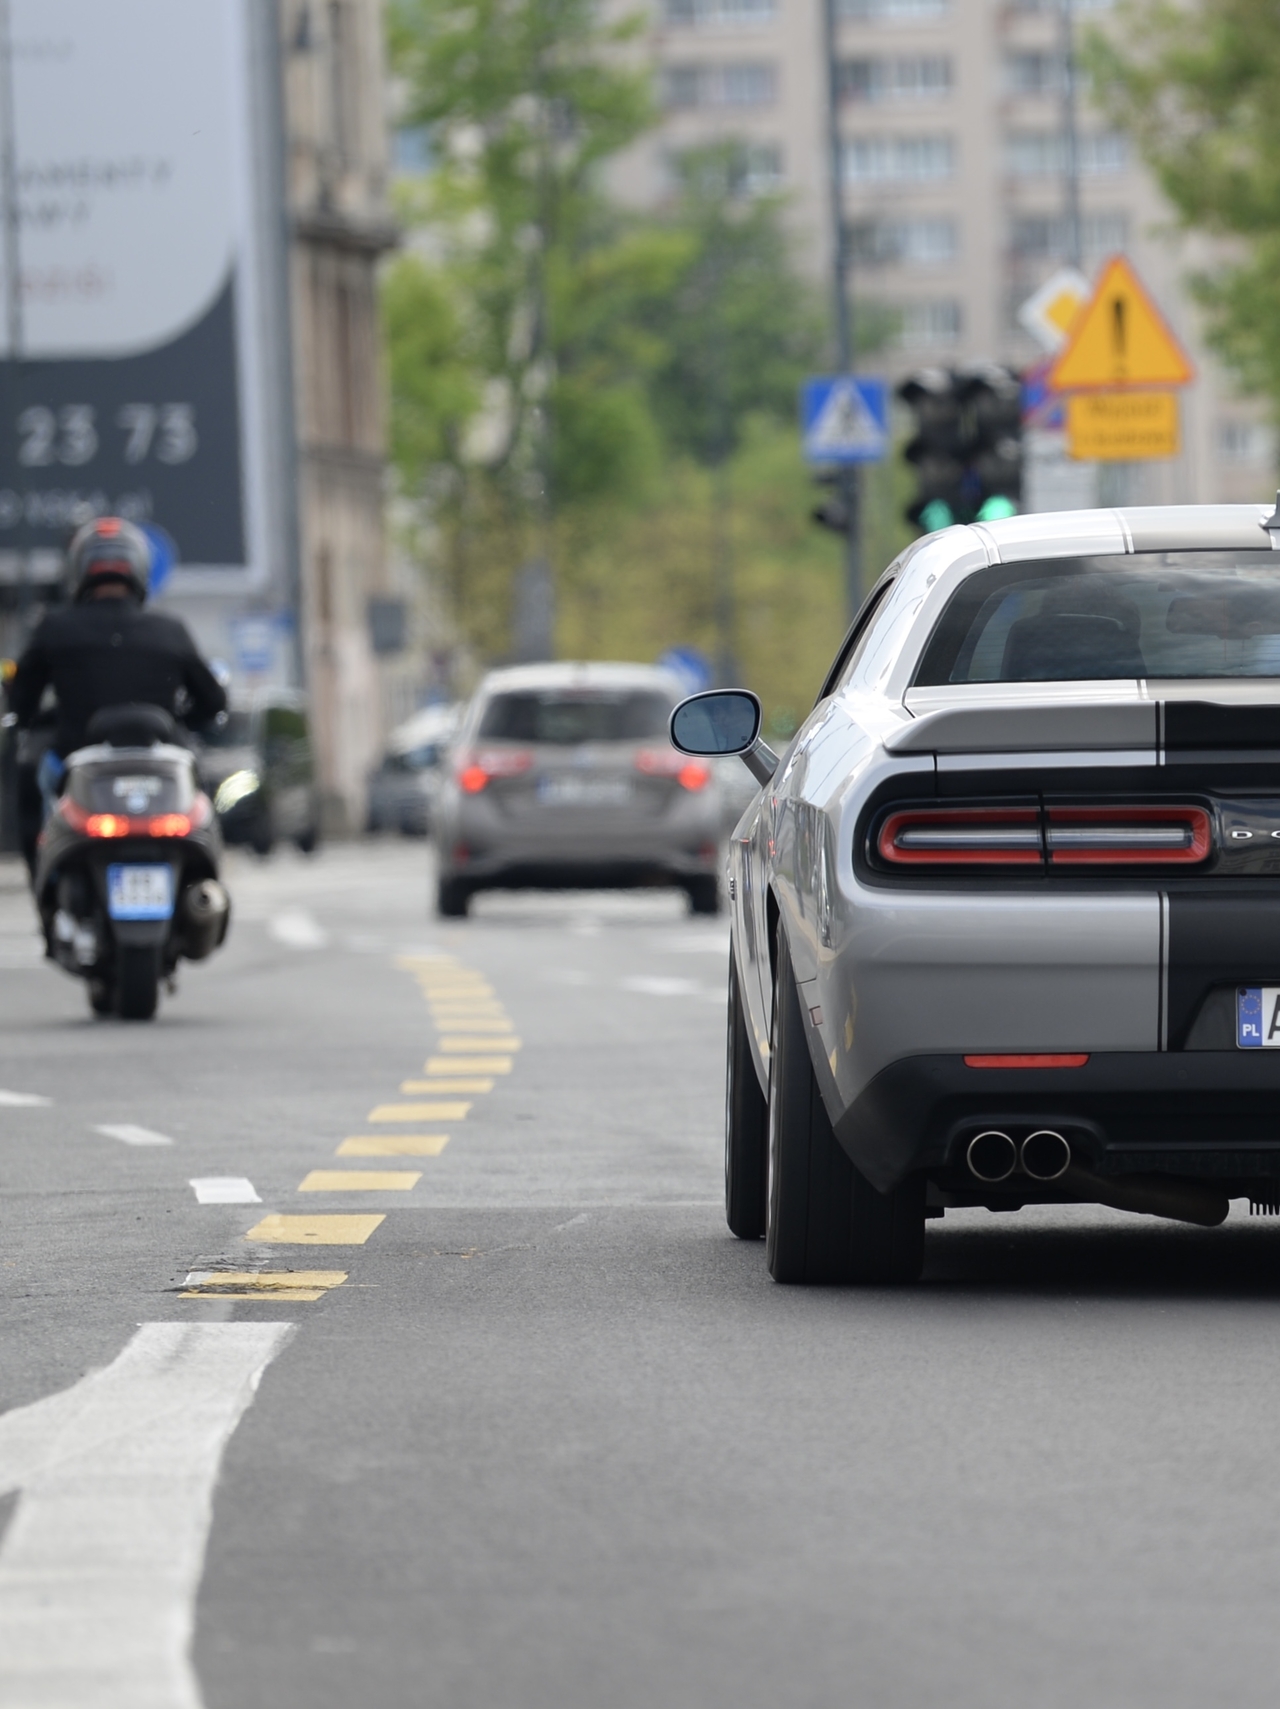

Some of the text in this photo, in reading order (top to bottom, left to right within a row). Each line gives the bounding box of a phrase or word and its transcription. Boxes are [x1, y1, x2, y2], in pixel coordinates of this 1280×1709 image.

[18, 402, 199, 466] 23 73
[1242, 1023, 1260, 1037] PL
